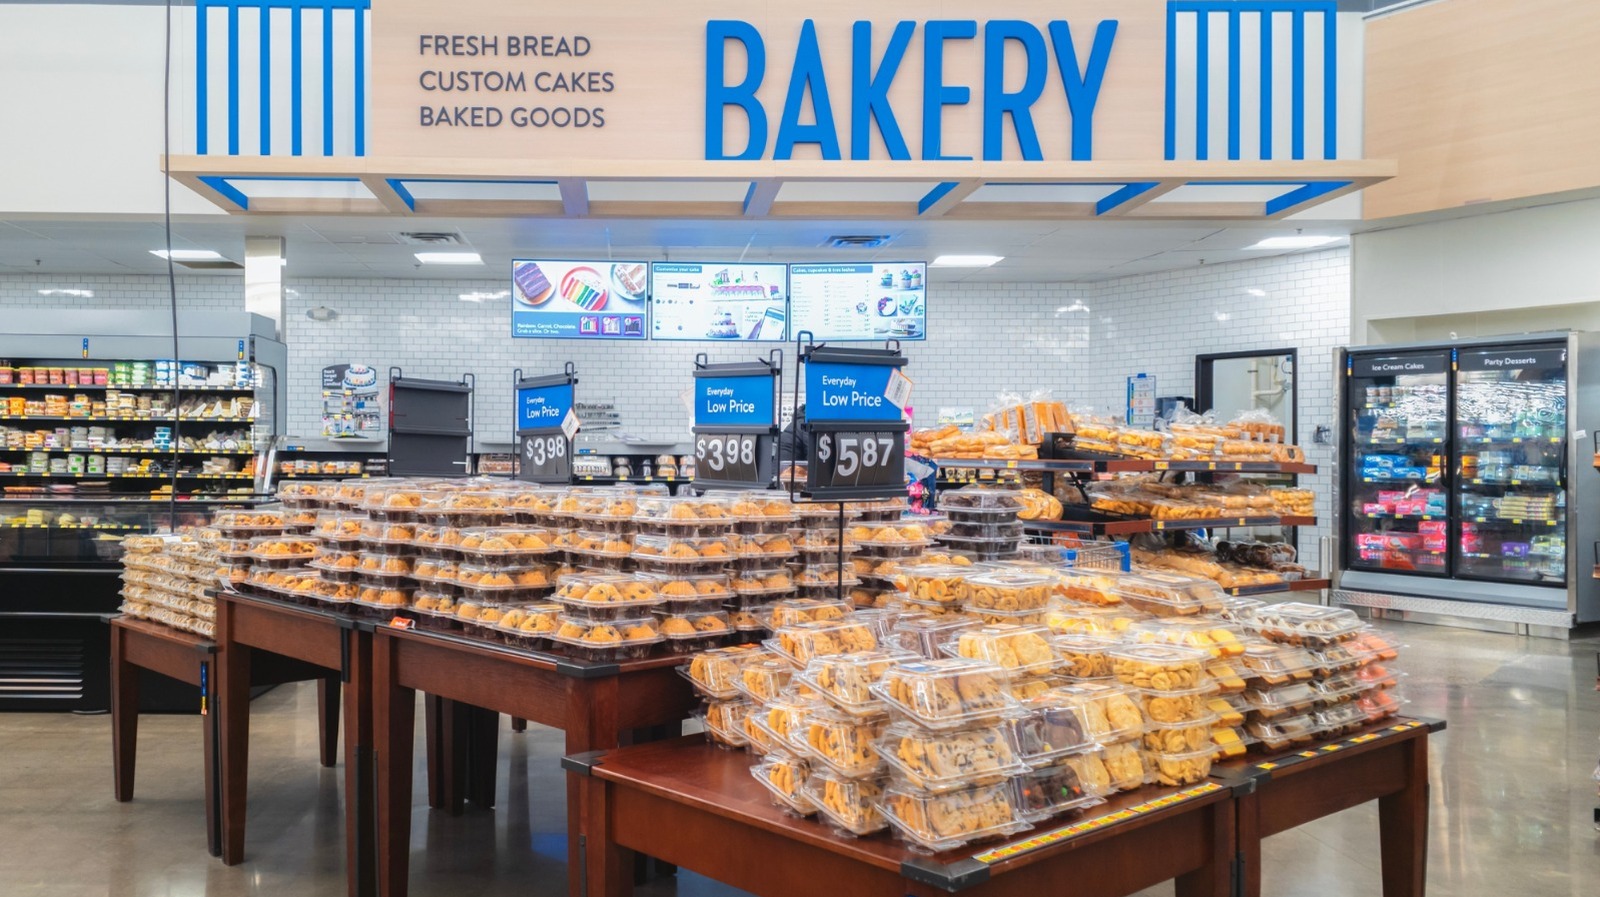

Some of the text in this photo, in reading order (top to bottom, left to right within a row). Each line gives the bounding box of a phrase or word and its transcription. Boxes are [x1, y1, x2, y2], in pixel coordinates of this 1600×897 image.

[419, 34, 592, 57] FRESH BREAD
[419, 70, 615, 93] CUSTOM CAKES
[704, 18, 1119, 161] BAKERY
[419, 105, 606, 128] BAKED GOODS
[1382, 363, 1404, 371] Cream
[1484, 357, 1537, 367] Party Desserts
[821, 375, 857, 389] Everyday
[706, 387, 734, 398] Everyday
[822, 390, 883, 408] Low Price
[526, 396, 546, 405] Everyday
[707, 399, 755, 413] Low Price
[526, 406, 560, 419] Low Price
